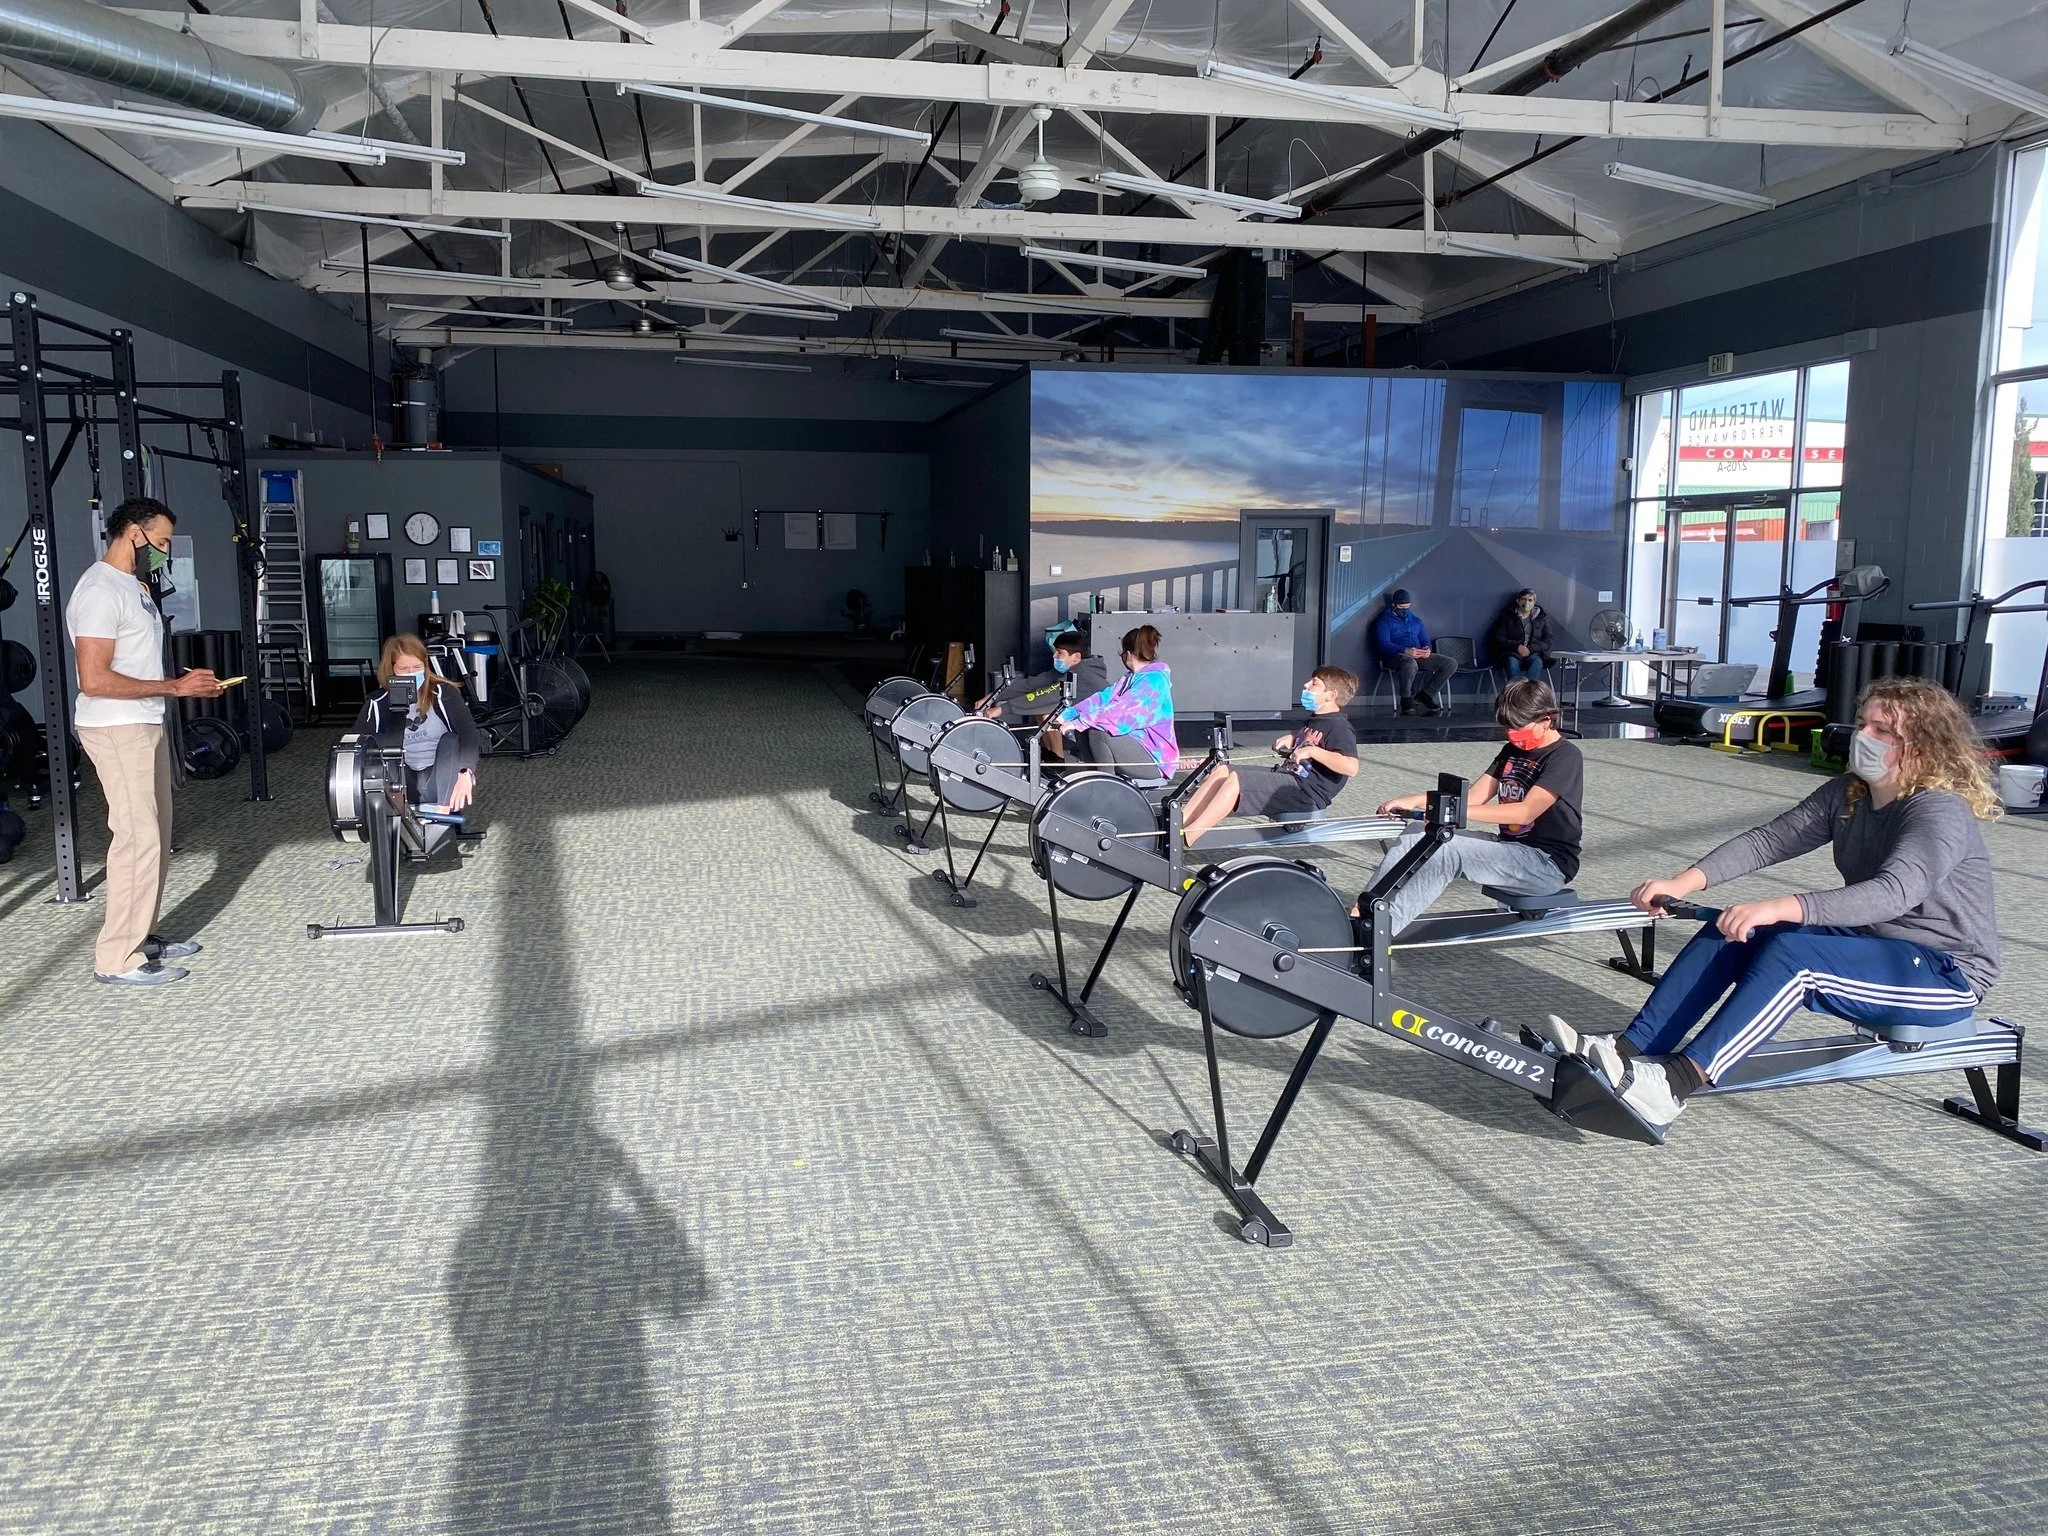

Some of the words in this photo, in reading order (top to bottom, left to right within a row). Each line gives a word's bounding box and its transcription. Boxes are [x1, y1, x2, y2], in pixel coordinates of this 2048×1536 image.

[1711, 354, 1727, 373] EXIT
[1706, 448, 1836, 460] CONDESE
[33, 527, 51, 597] ROGUE
[1497, 781, 1525, 801] NASA
[1426, 1025, 1528, 1075] concept
[1527, 1064, 1546, 1083] 2
